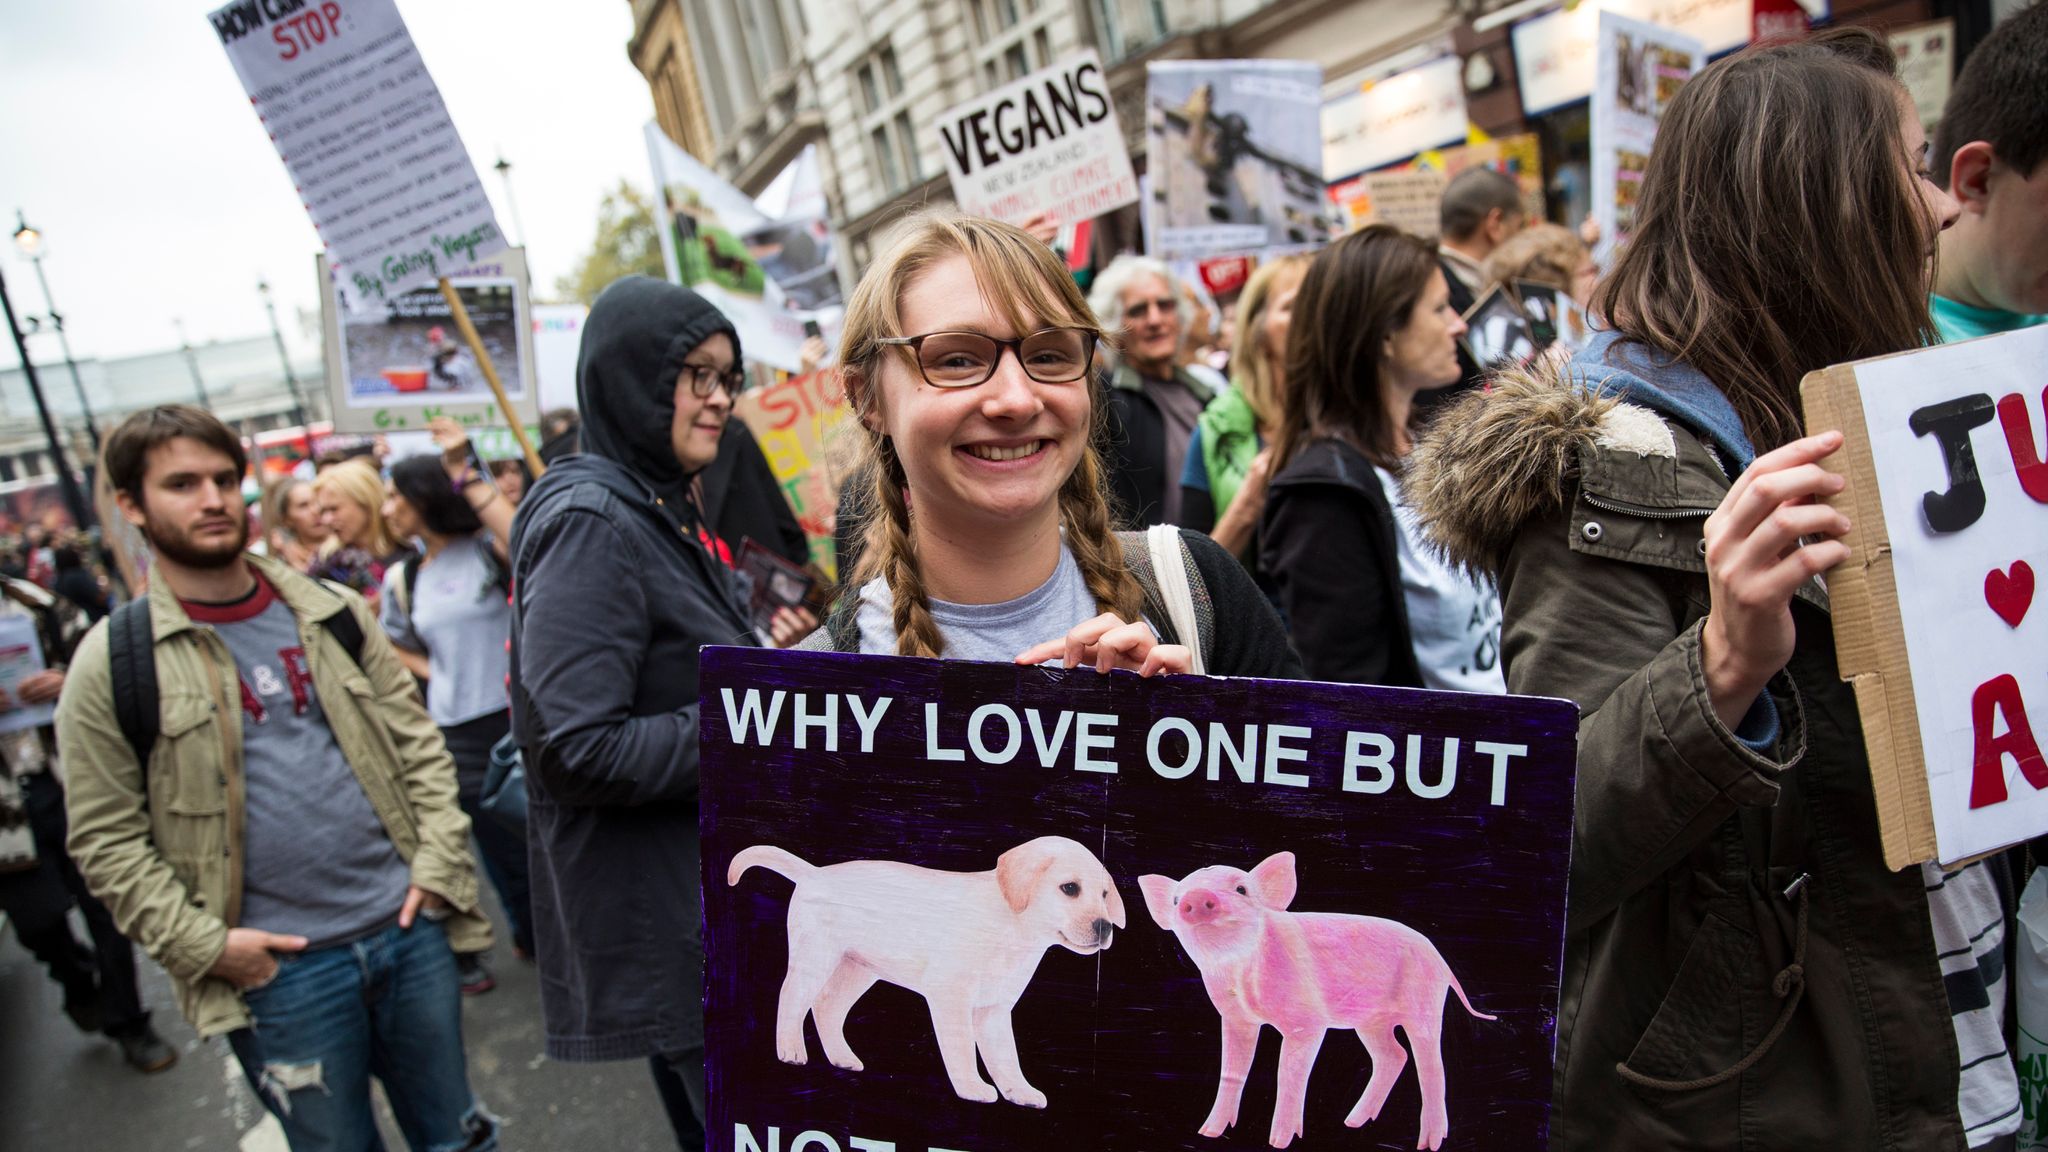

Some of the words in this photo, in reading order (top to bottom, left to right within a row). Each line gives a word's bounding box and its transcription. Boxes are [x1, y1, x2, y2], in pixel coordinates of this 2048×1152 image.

[941, 63, 1108, 176] VEGANS
[721, 689, 893, 753] WHY
[925, 702, 1119, 774] LOVE
[1146, 716, 1312, 788] ONE
[1342, 730, 1528, 806] BUT
